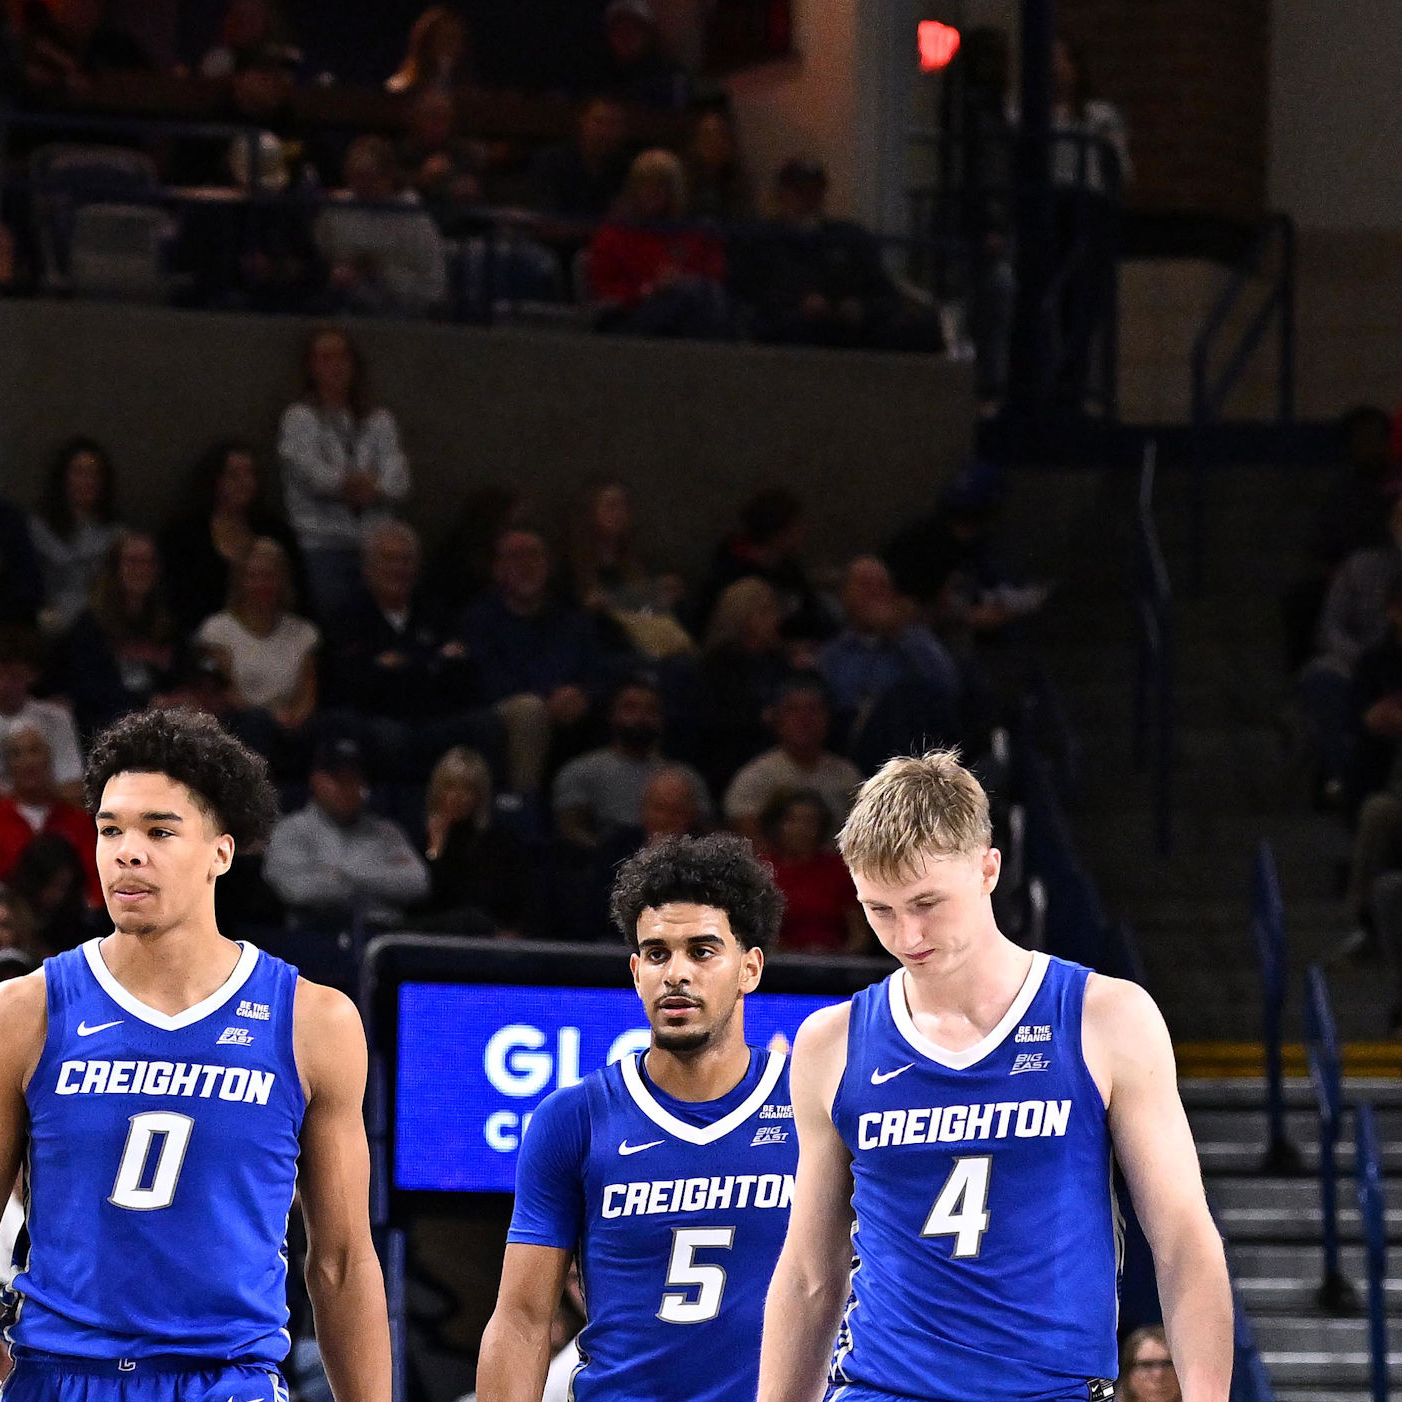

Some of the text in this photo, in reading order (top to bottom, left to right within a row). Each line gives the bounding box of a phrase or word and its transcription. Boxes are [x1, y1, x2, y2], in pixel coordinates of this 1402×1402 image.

[239, 1000, 270, 1013] BE THE
[235, 1008, 271, 1021] CHANGE
[223, 1027, 250, 1036] BIG
[1018, 1025, 1051, 1035] BE THE
[218, 1034, 255, 1044] EAST
[1014, 1033, 1052, 1043] CHANGE
[1014, 1053, 1044, 1063] BIG
[1011, 1060, 1052, 1071] EAST
[55, 1060, 275, 1106] CREIGHTON
[762, 1104, 794, 1113] BE THE
[758, 1111, 795, 1119] CHANGE
[755, 1125, 782, 1136] BIG
[857, 1099, 1072, 1151] CREIGHTON
[752, 1132, 790, 1143] EAST
[107, 1111, 195, 1212] 0
[920, 1154, 994, 1260] 4
[655, 1226, 736, 1325] 5
